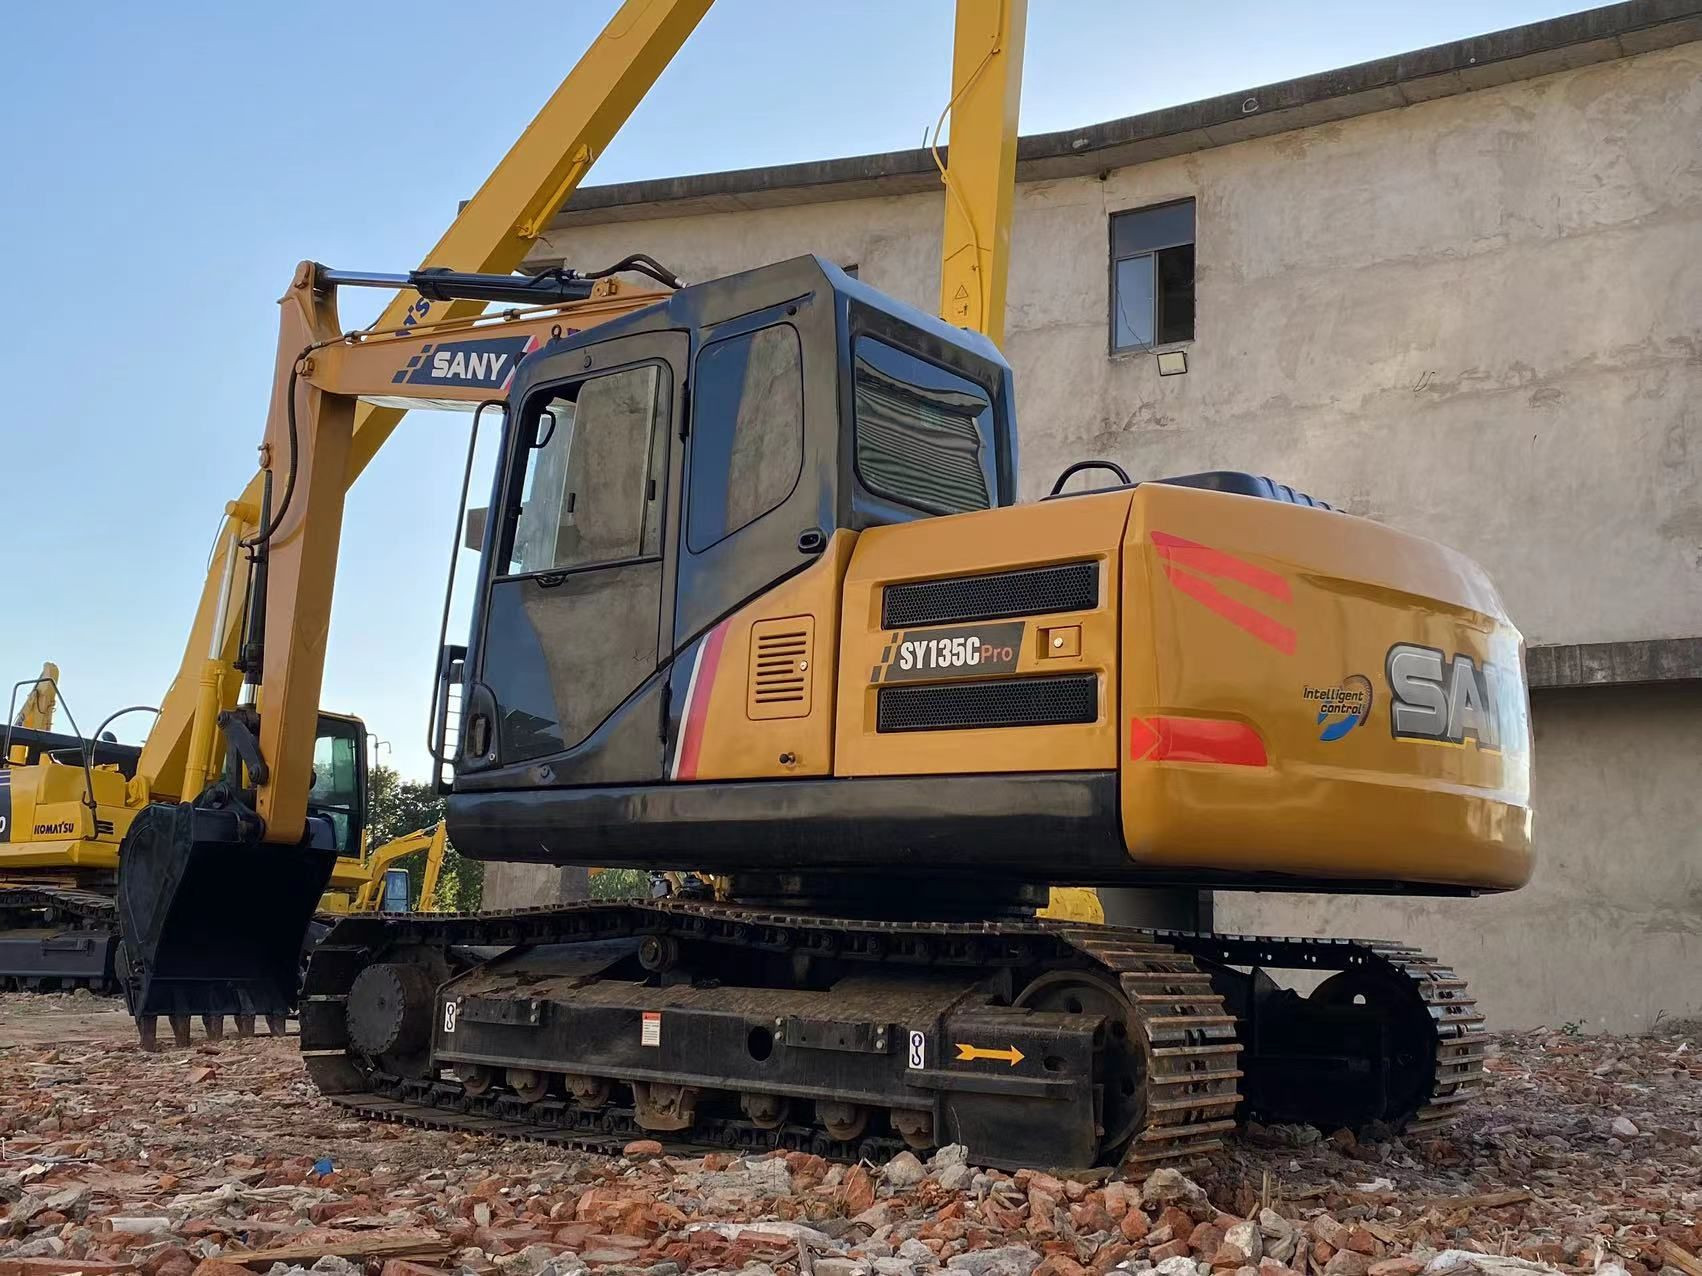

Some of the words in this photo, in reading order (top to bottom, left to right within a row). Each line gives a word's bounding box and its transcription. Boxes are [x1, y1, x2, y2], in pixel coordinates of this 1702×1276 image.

[432, 351, 508, 380] SANY
[1304, 688, 1364, 703] Intelligent
[1320, 703, 1362, 714] control
